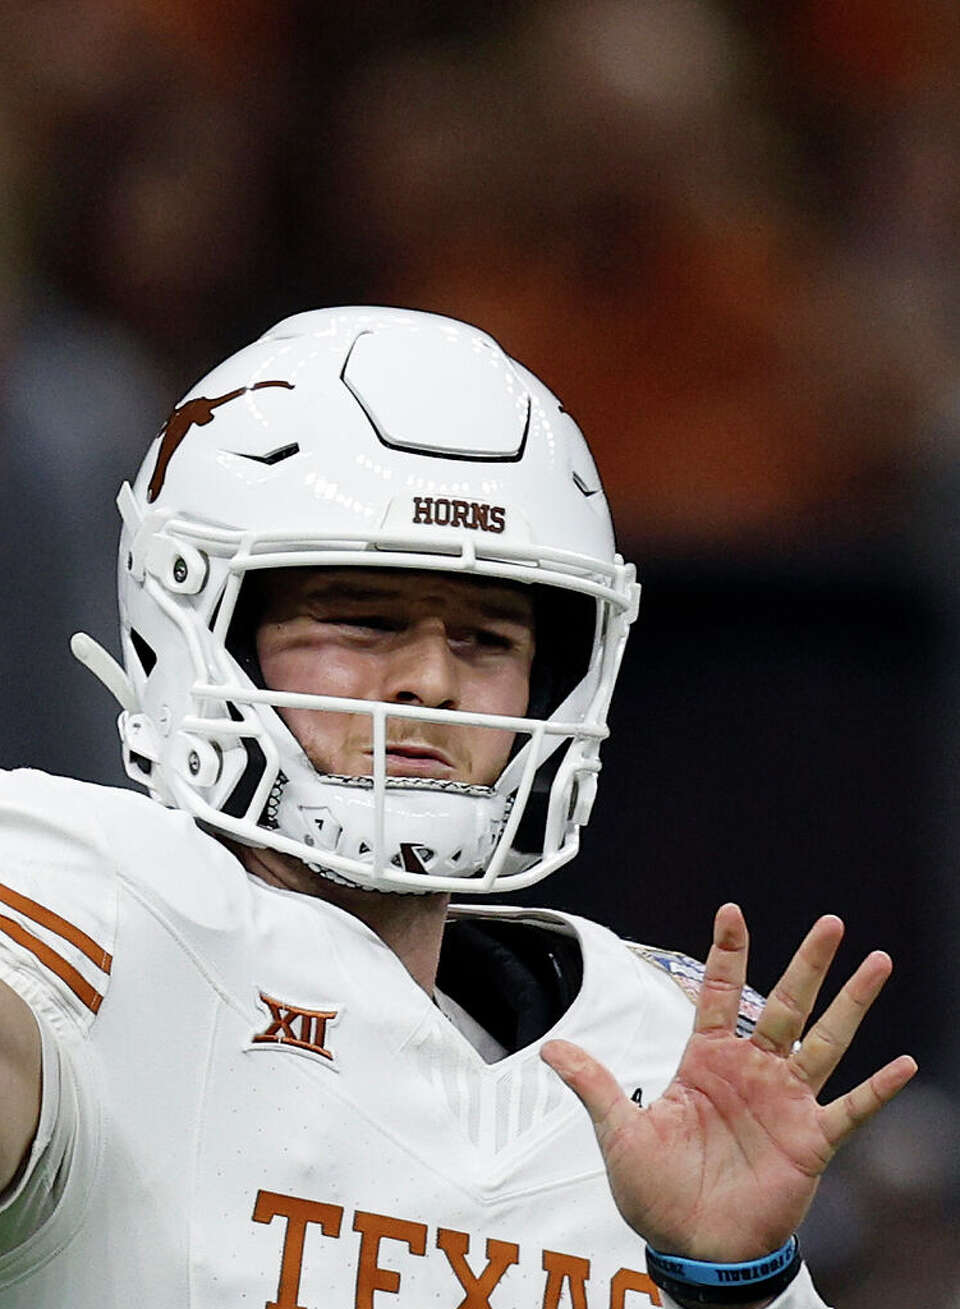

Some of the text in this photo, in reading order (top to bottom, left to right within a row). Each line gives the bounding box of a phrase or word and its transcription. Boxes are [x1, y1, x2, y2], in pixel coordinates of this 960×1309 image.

[413, 496, 506, 534] HORNS
[251, 991, 339, 1061] XII
[715, 1255, 785, 1283] FOOTBALL
